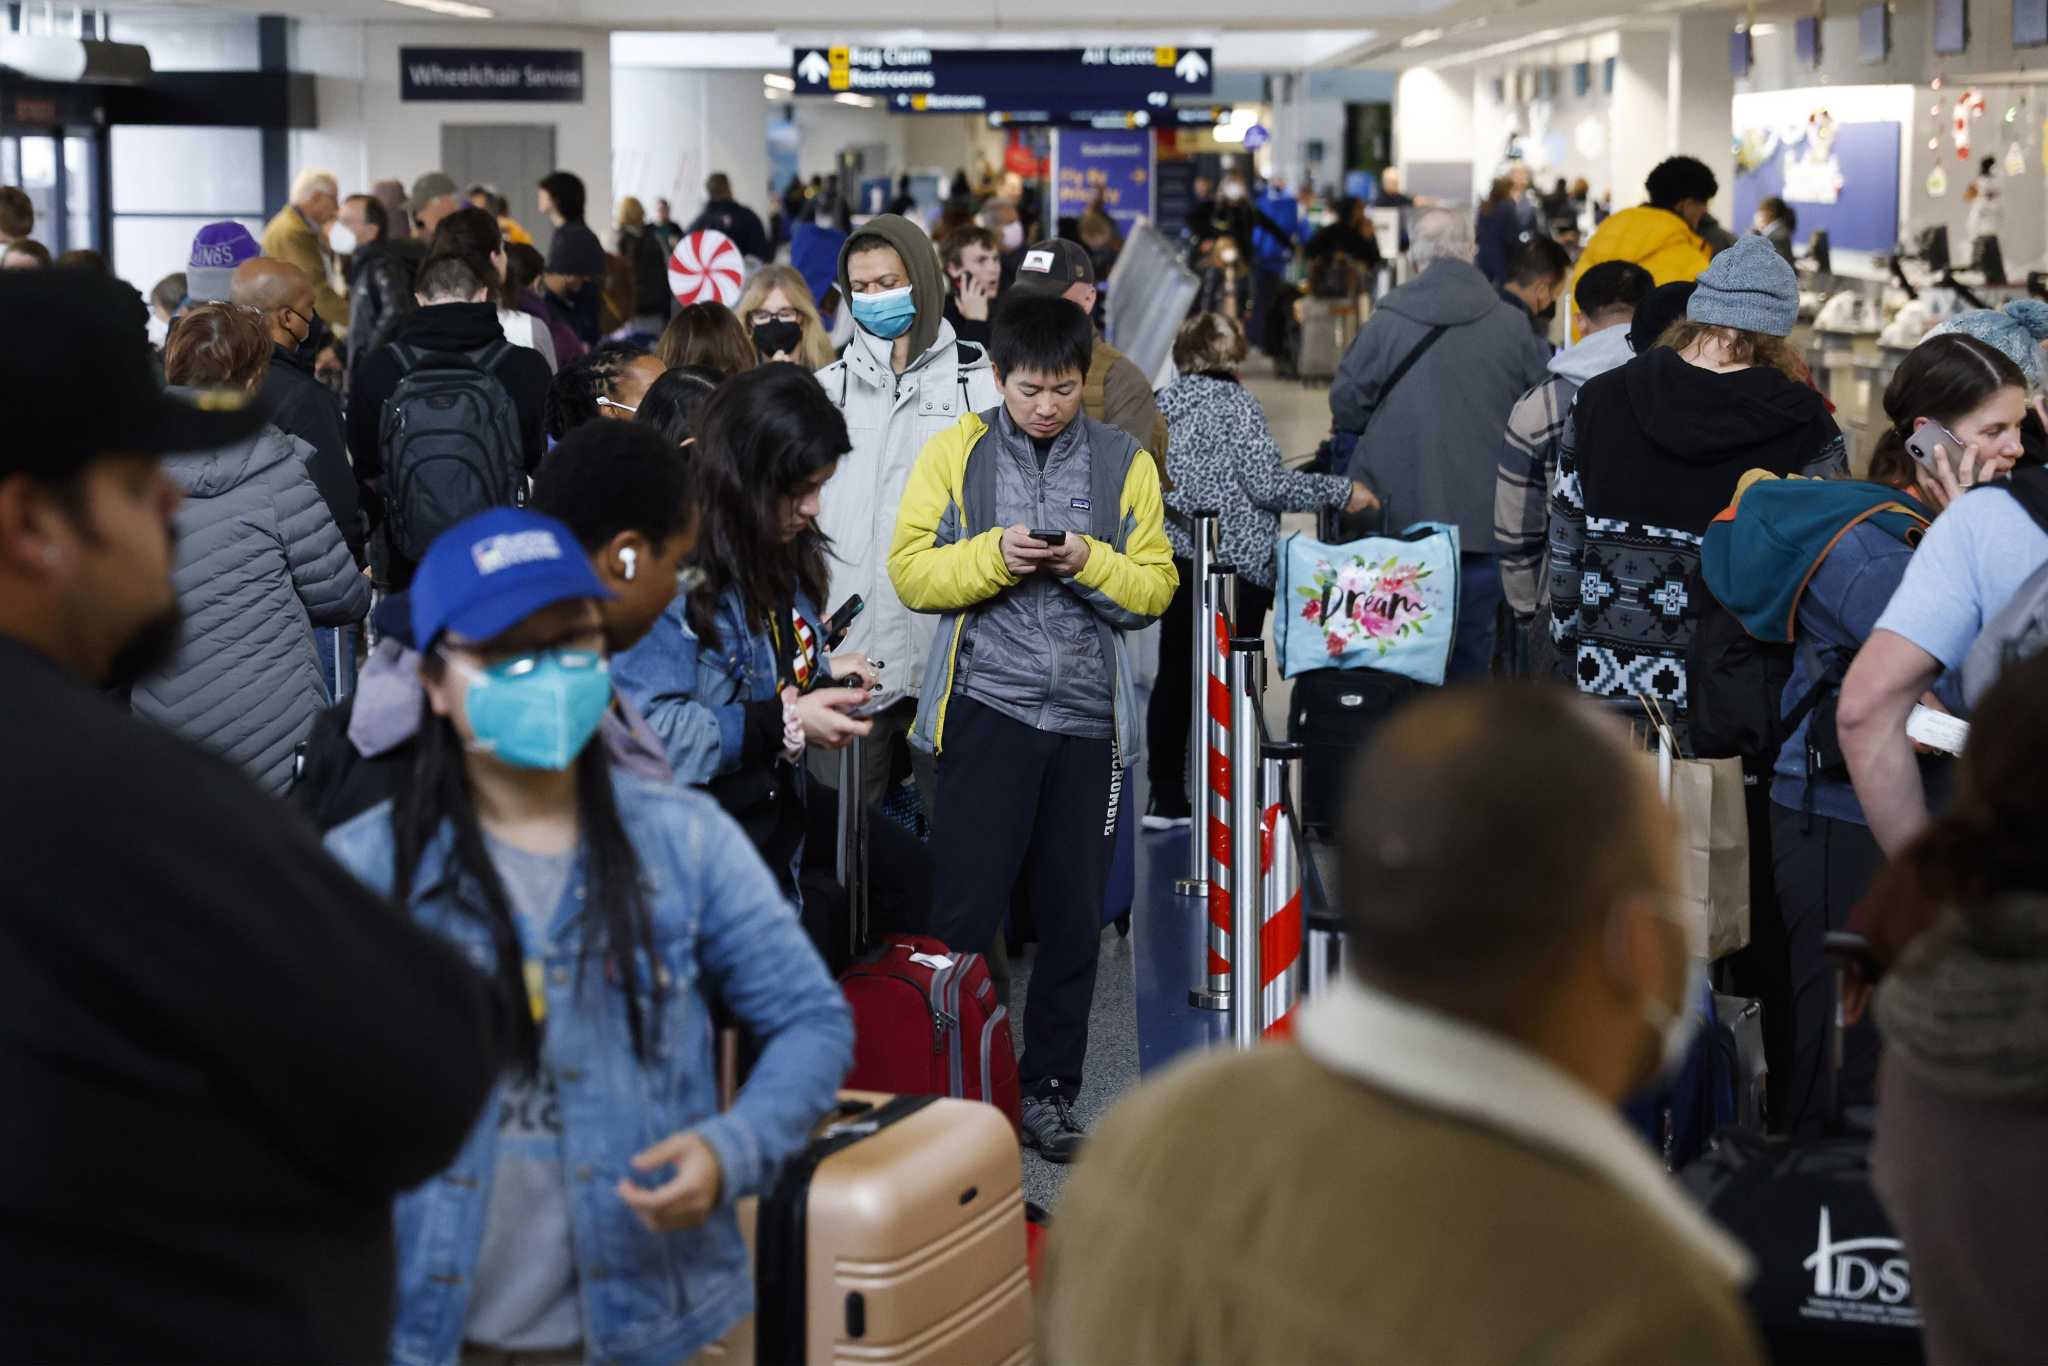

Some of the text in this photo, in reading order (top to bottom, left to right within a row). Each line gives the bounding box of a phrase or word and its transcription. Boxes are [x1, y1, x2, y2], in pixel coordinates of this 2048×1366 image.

[409, 63, 521, 87] Wheelchair
[849, 69, 935, 88] Restrooms
[1319, 582, 1428, 627] Dream
